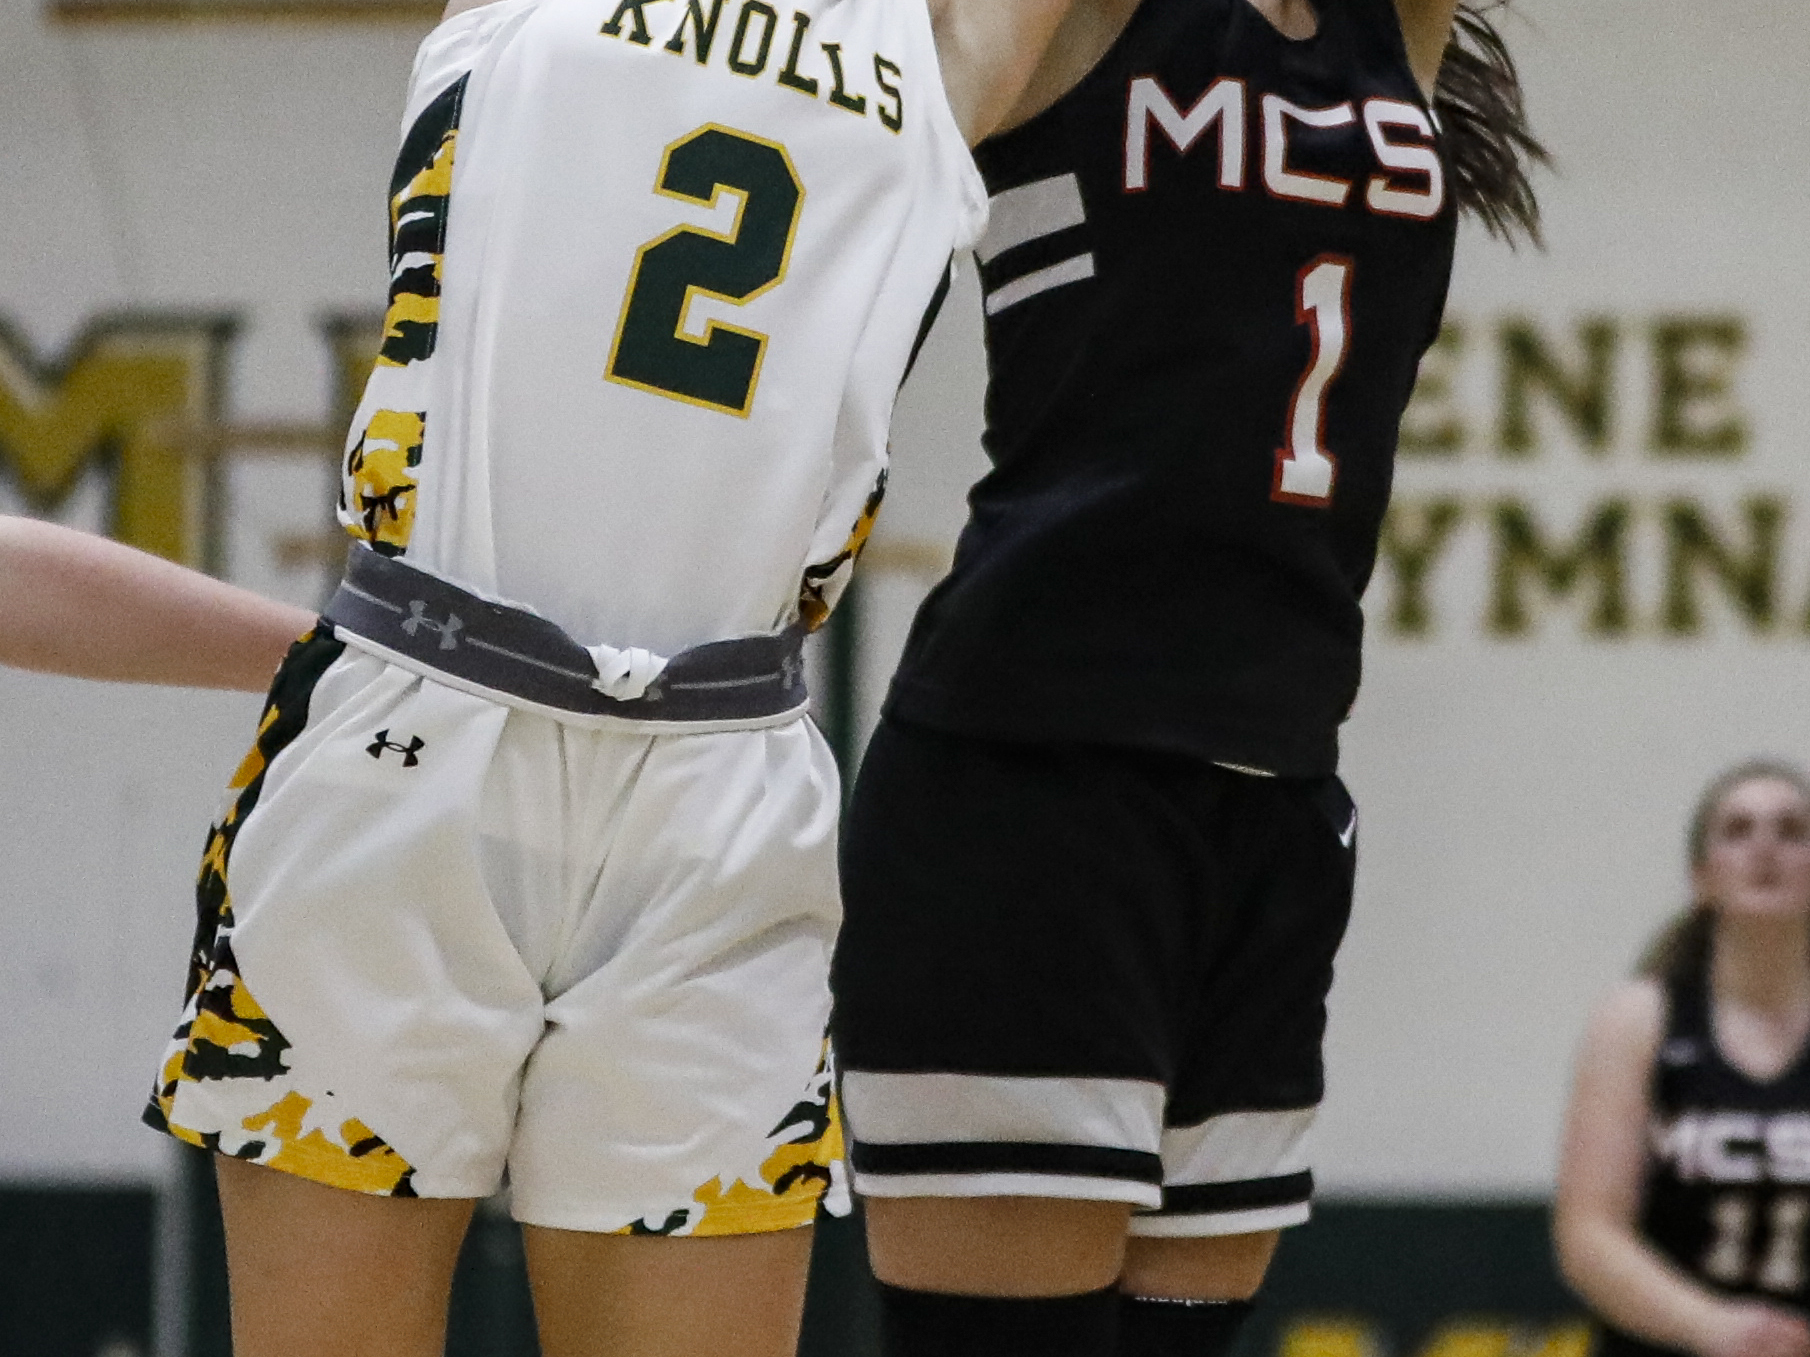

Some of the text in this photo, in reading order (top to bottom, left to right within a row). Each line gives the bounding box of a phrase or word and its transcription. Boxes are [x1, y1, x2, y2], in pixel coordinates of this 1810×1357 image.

[1122, 73, 1446, 221] MCS
[604, 121, 806, 419] 2
[1269, 251, 1353, 509] 1
[1377, 492, 1810, 642] YMN
